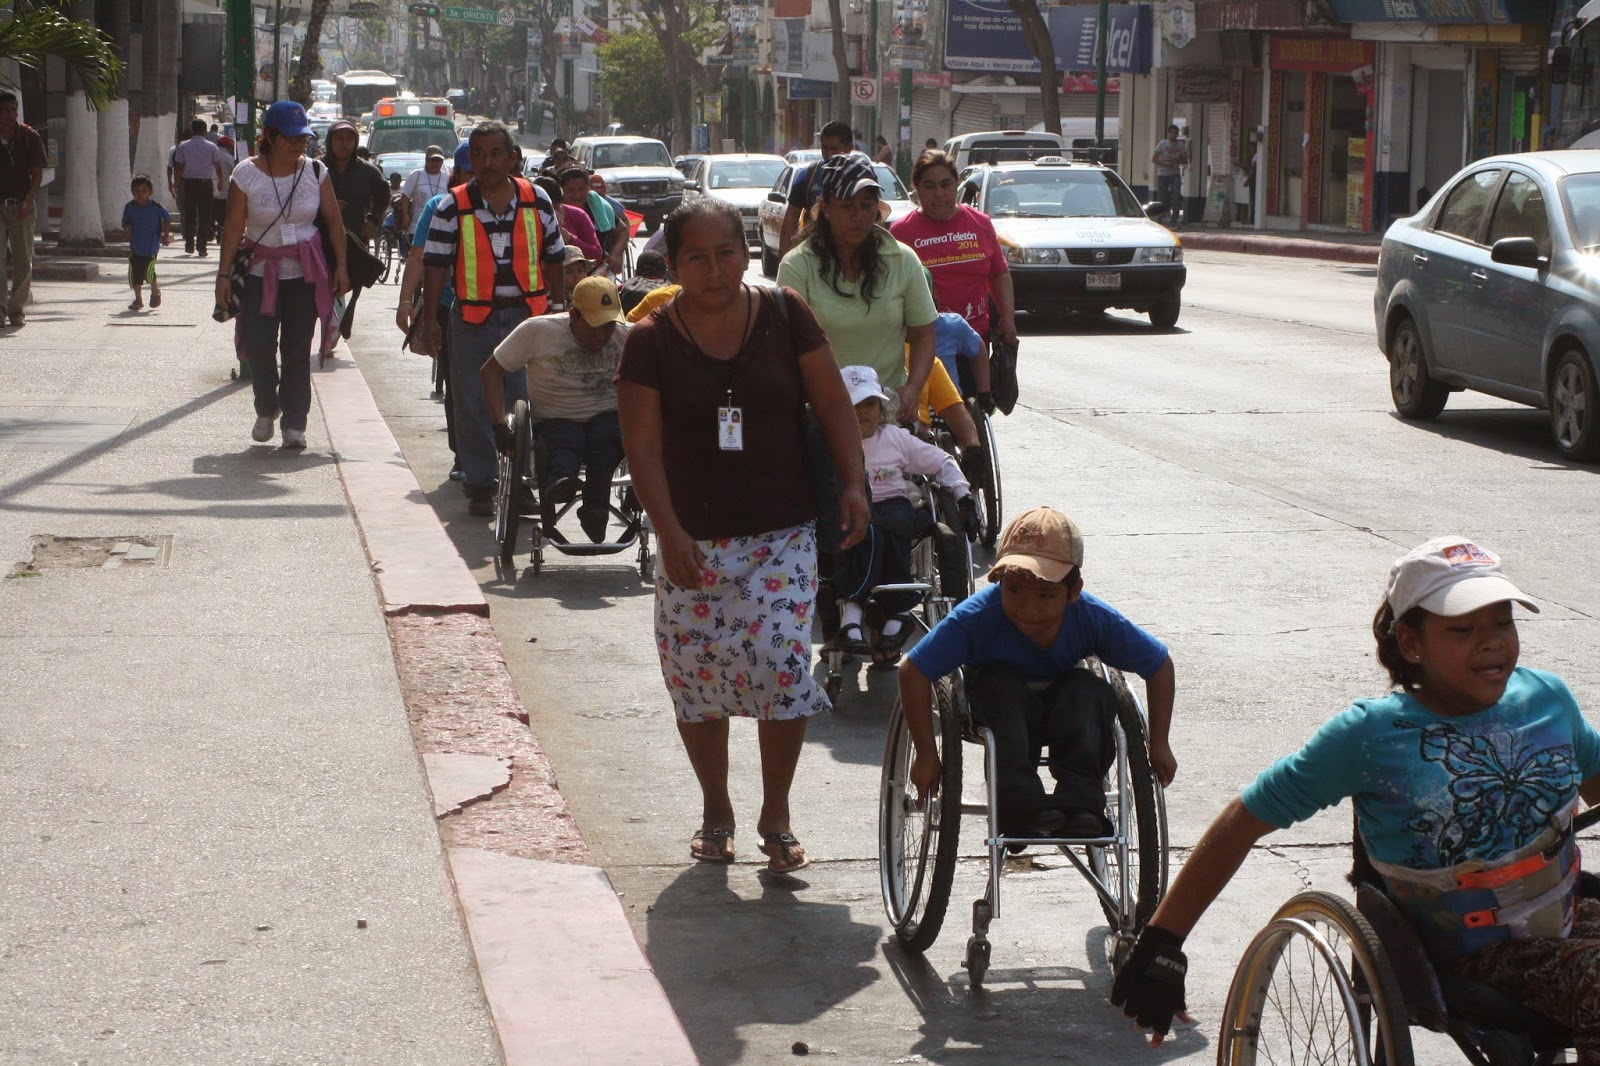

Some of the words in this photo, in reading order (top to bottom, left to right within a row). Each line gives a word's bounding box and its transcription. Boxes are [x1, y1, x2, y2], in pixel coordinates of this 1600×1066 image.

[463, 11, 495, 21] ORIENTE
[964, 15, 991, 23] Bodegas
[992, 15, 1001, 23] de
[1002, 16, 1022, 24] Calza
[1092, 17, 1137, 68] tlcel
[1012, 63, 1024, 71] por
[383, 118, 426, 127] PROTECCIÓN
[428, 119, 447, 127] CIVIL
[913, 234, 947, 249] Carrera
[947, 230, 978, 243] Teletón
[957, 240, 979, 250] 2014
